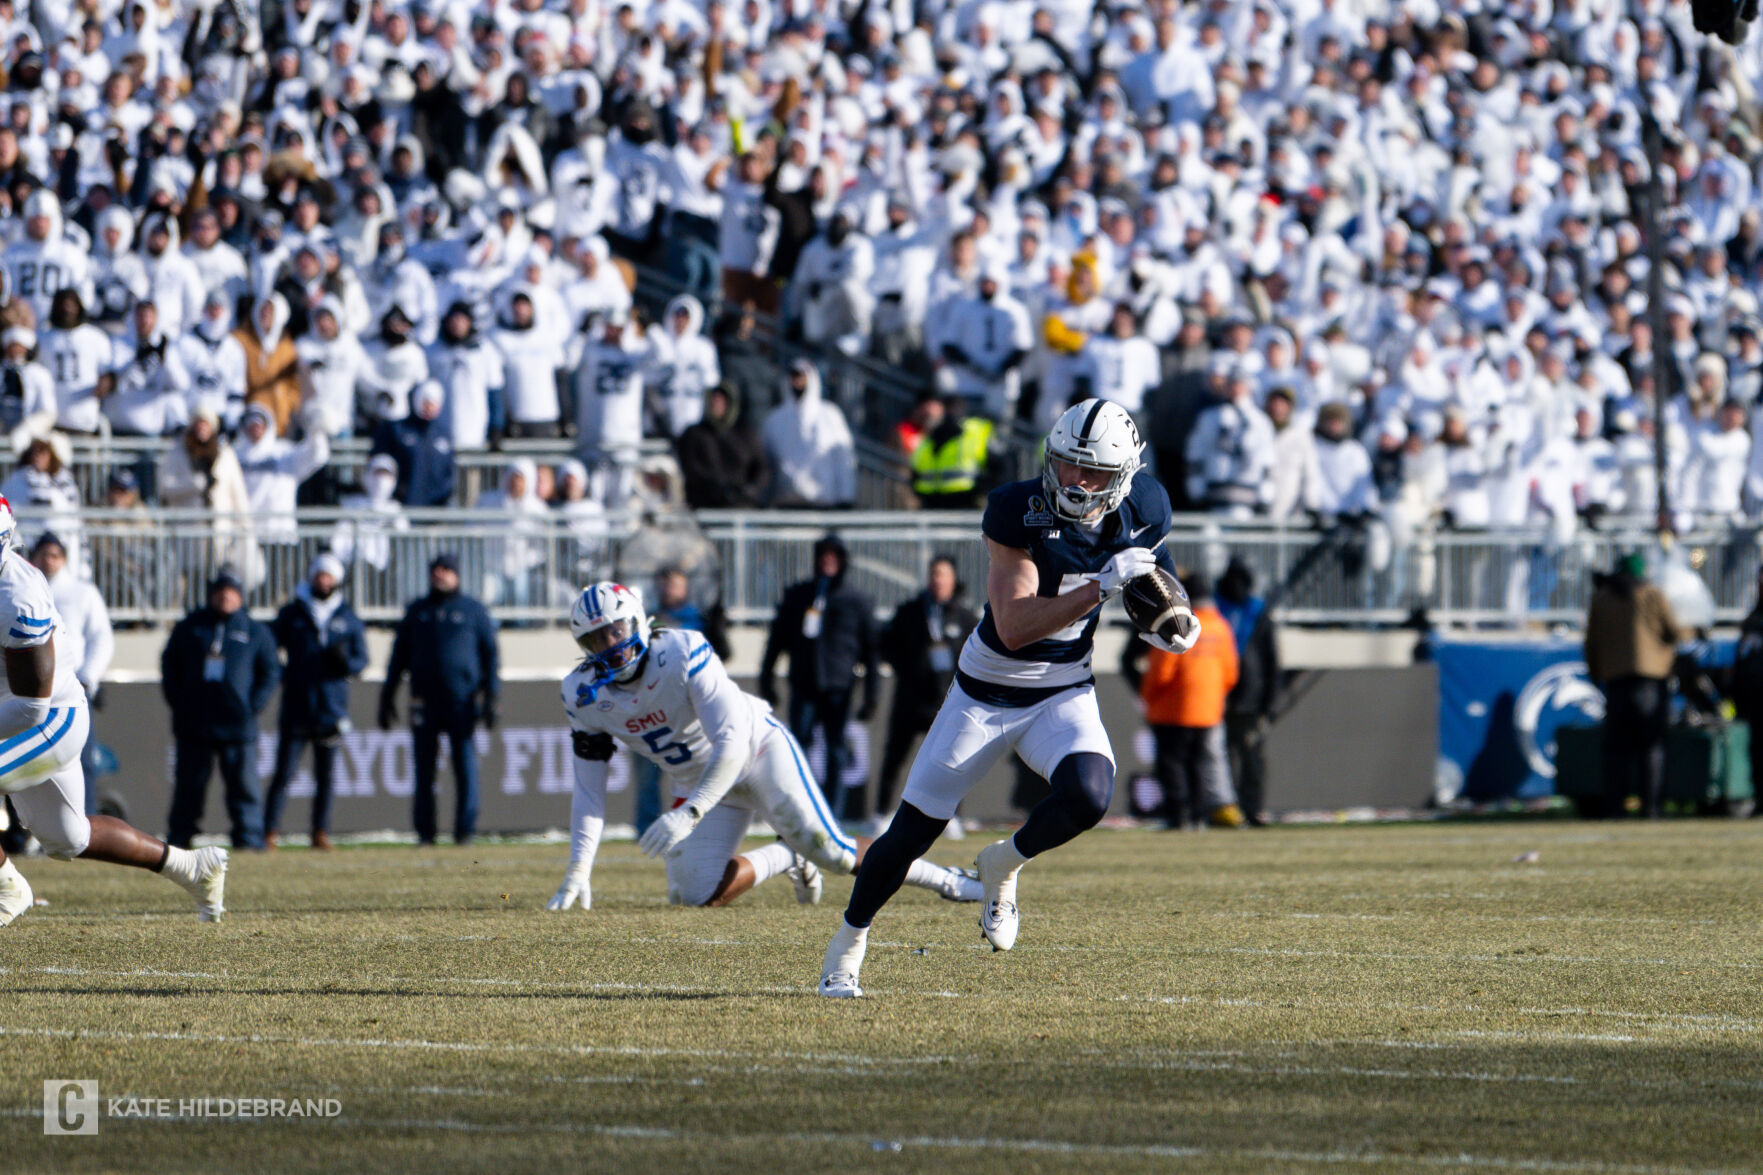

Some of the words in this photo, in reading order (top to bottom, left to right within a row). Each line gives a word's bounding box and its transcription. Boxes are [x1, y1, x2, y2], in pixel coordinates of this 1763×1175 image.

[657, 650, 667, 668] C
[625, 709, 668, 734] SMU
[641, 726, 692, 765] 5
